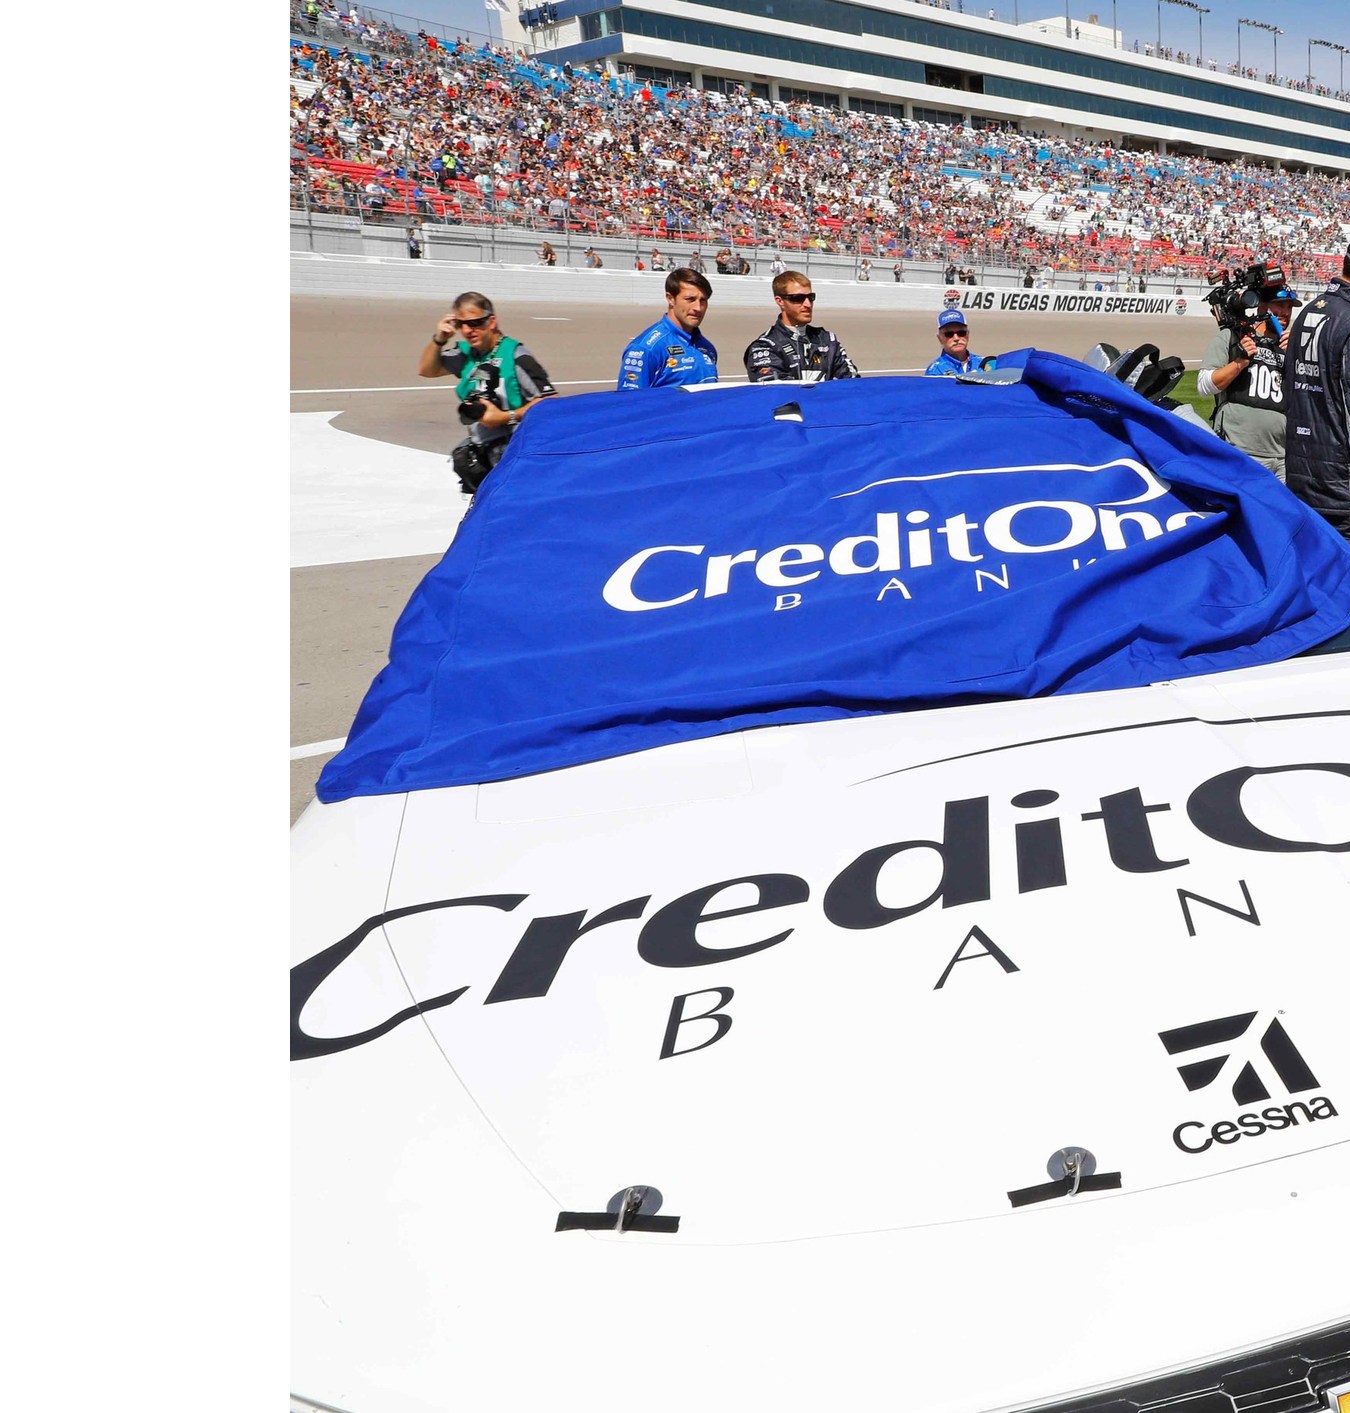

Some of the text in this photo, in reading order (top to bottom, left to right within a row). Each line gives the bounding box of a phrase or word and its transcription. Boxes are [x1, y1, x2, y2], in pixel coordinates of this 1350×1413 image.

[962, 291, 1174, 314] LAS VEGAS MOTOR SPEEDWAY
[1248, 364, 1283, 403] 109
[1295, 359, 1319, 377] Cessna
[1173, 1096, 1339, 1154] Cessna
